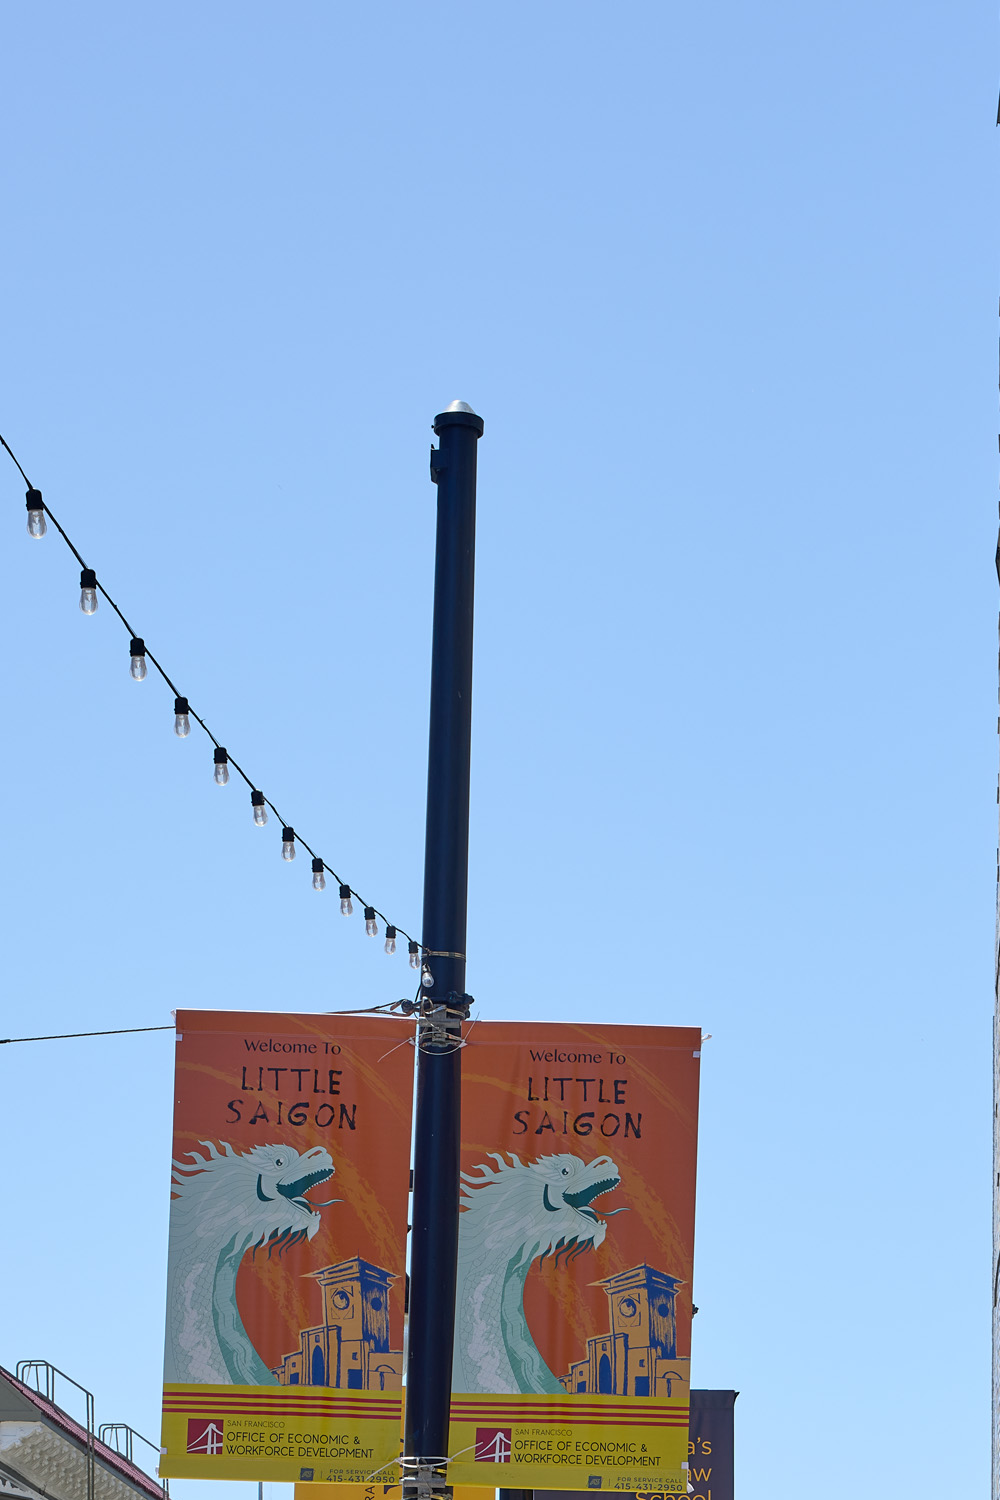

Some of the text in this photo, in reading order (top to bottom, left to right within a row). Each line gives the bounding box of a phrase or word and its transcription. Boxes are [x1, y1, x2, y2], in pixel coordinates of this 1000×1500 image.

[244, 1039, 342, 1055] Welcome To
[529, 1049, 626, 1065] Welcome To
[241, 1066, 343, 1095] LITTLE
[527, 1076, 628, 1105] LITTLE
[226, 1099, 357, 1130] SAIGON
[512, 1110, 642, 1138] SAIGON
[244, 1420, 285, 1428] FRANCISCO
[226, 1432, 361, 1445] OFFICE OF ECONOMIC &
[226, 1445, 374, 1459] WORKFORCE DEVELOPMENT
[514, 1440, 648, 1453] OFFICE OF ECONOMIC &
[514, 1454, 661, 1466] WORKFORCE DEVELOPMENT
[326, 1474, 395, 1483] 415-4312950
[614, 1482, 683, 1492] 415-431-2950
